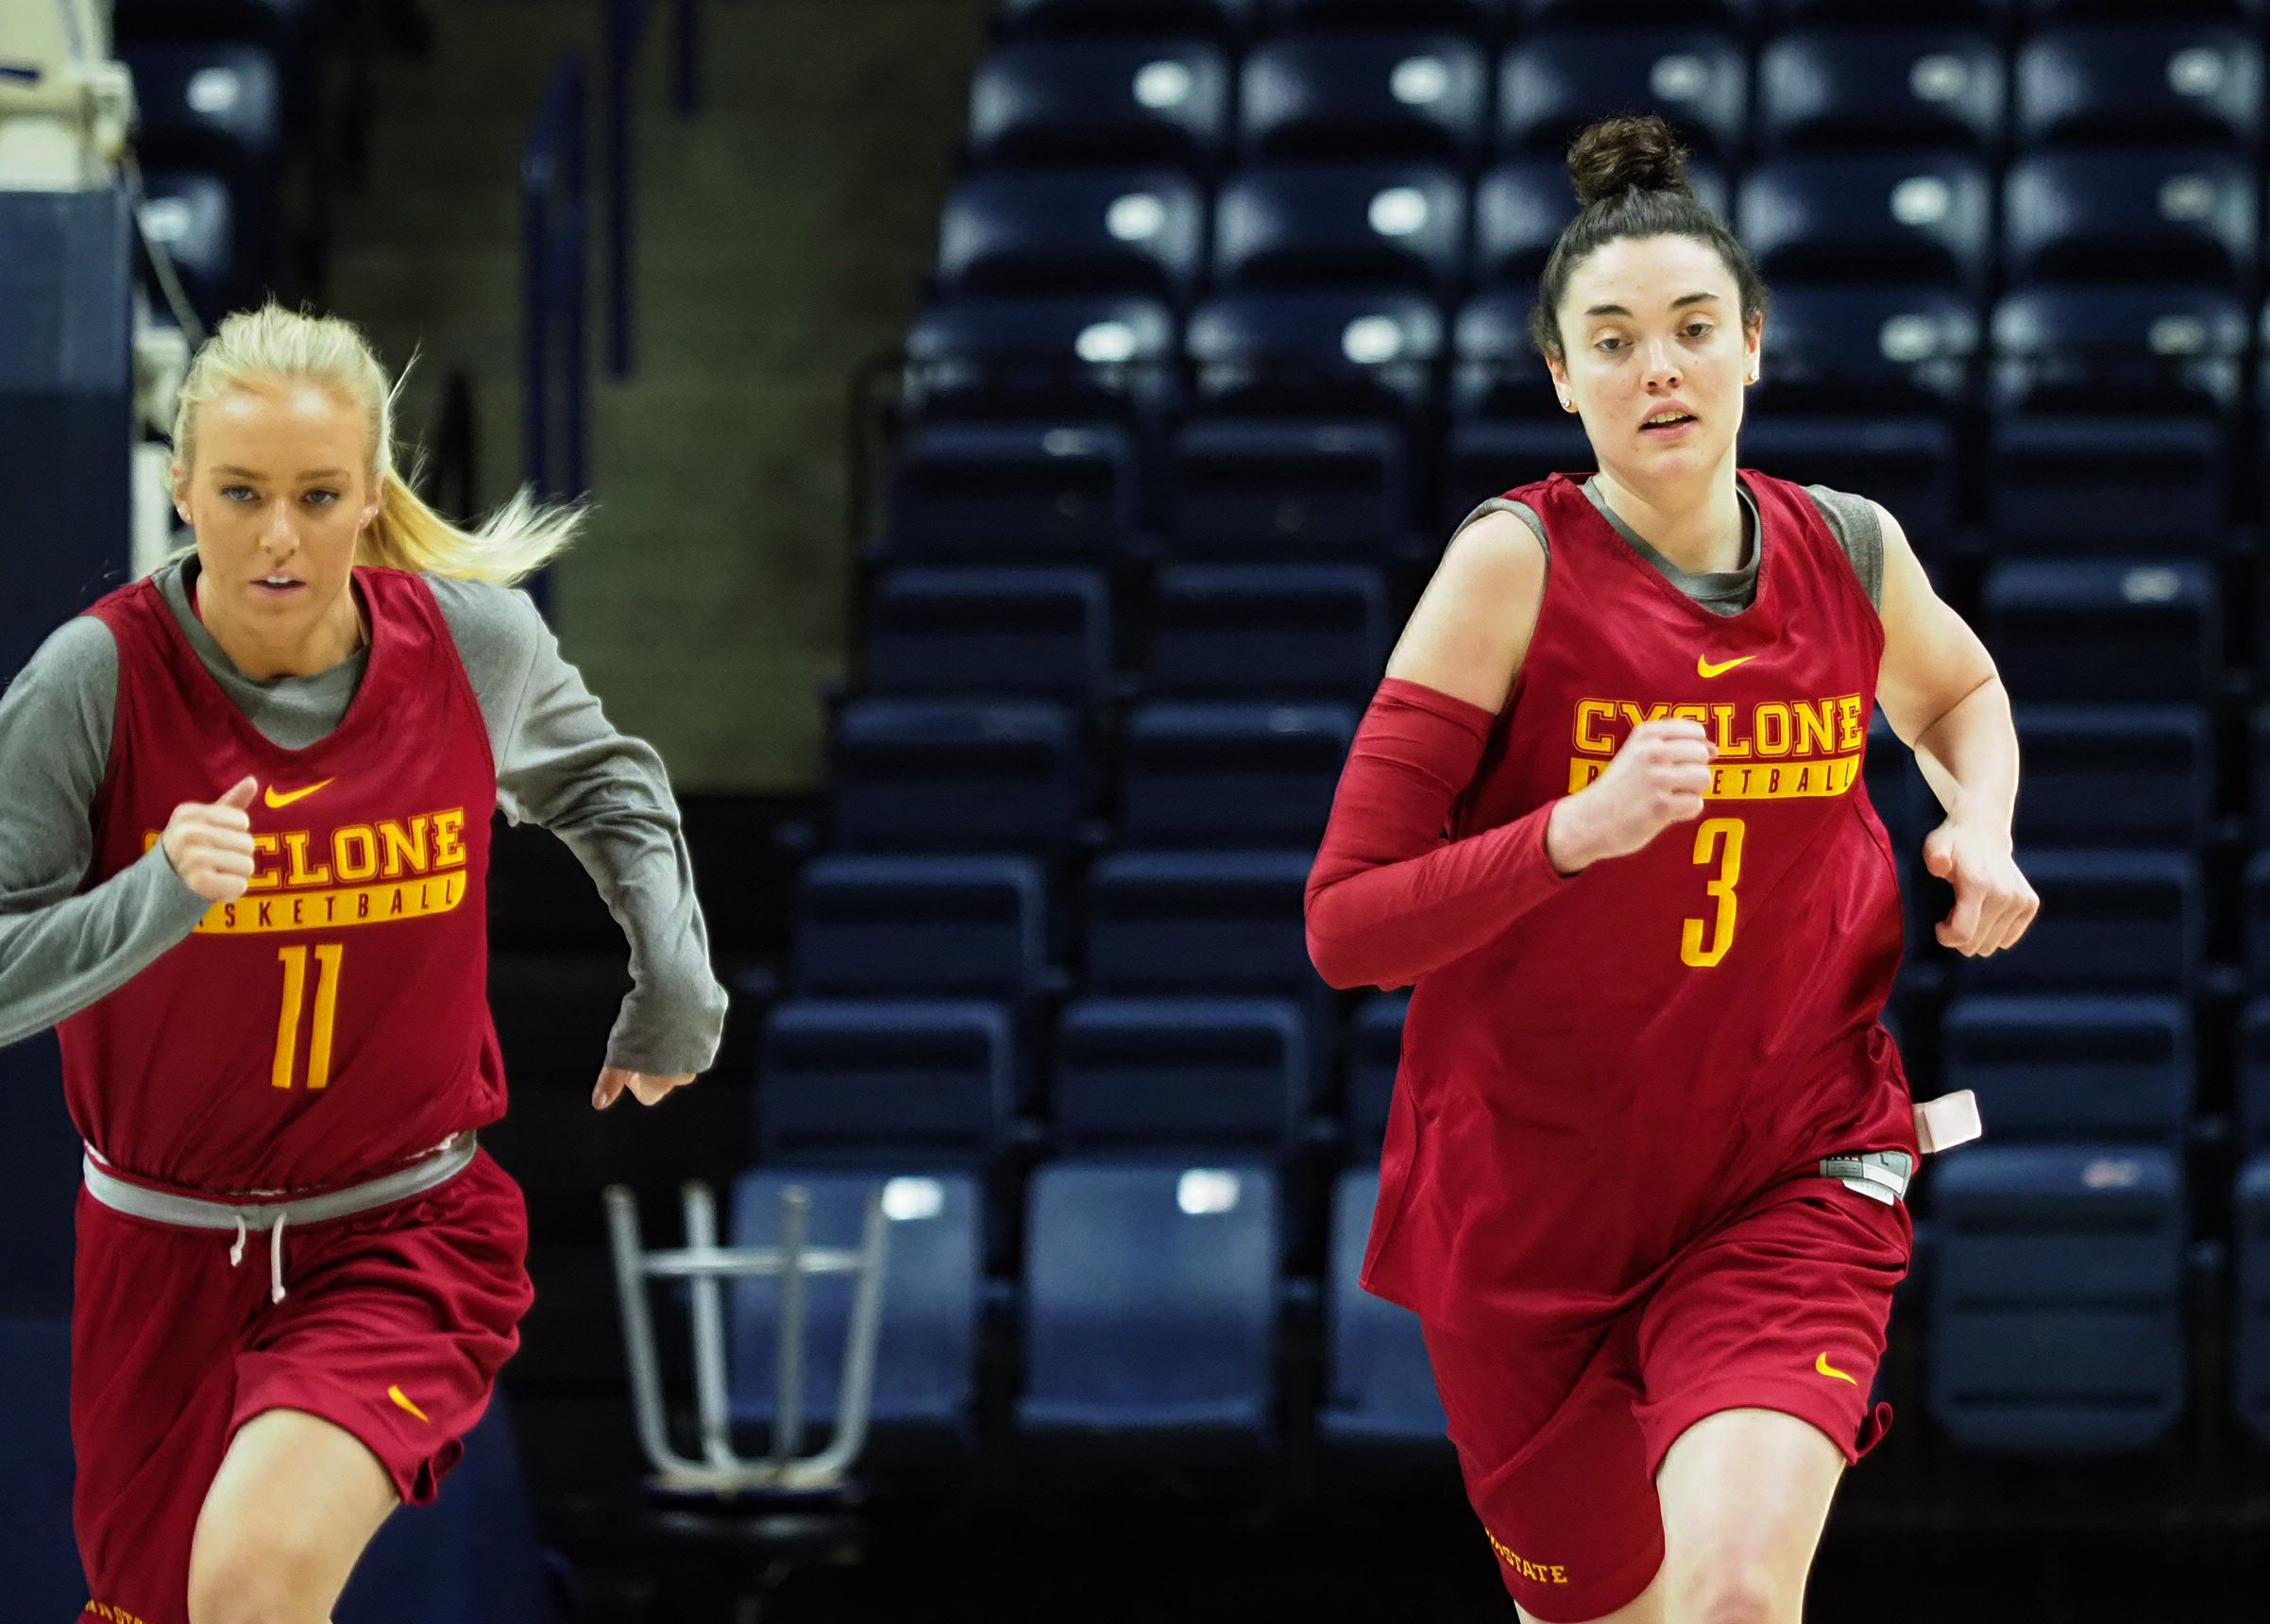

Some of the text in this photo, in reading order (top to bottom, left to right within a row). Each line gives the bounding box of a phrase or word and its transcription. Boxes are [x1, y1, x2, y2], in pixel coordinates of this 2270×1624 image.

[142, 805, 467, 890] CLONE
[199, 878, 453, 929] SKETBALL
[1681, 818, 1745, 967] 3
[271, 943, 344, 1089] 11
